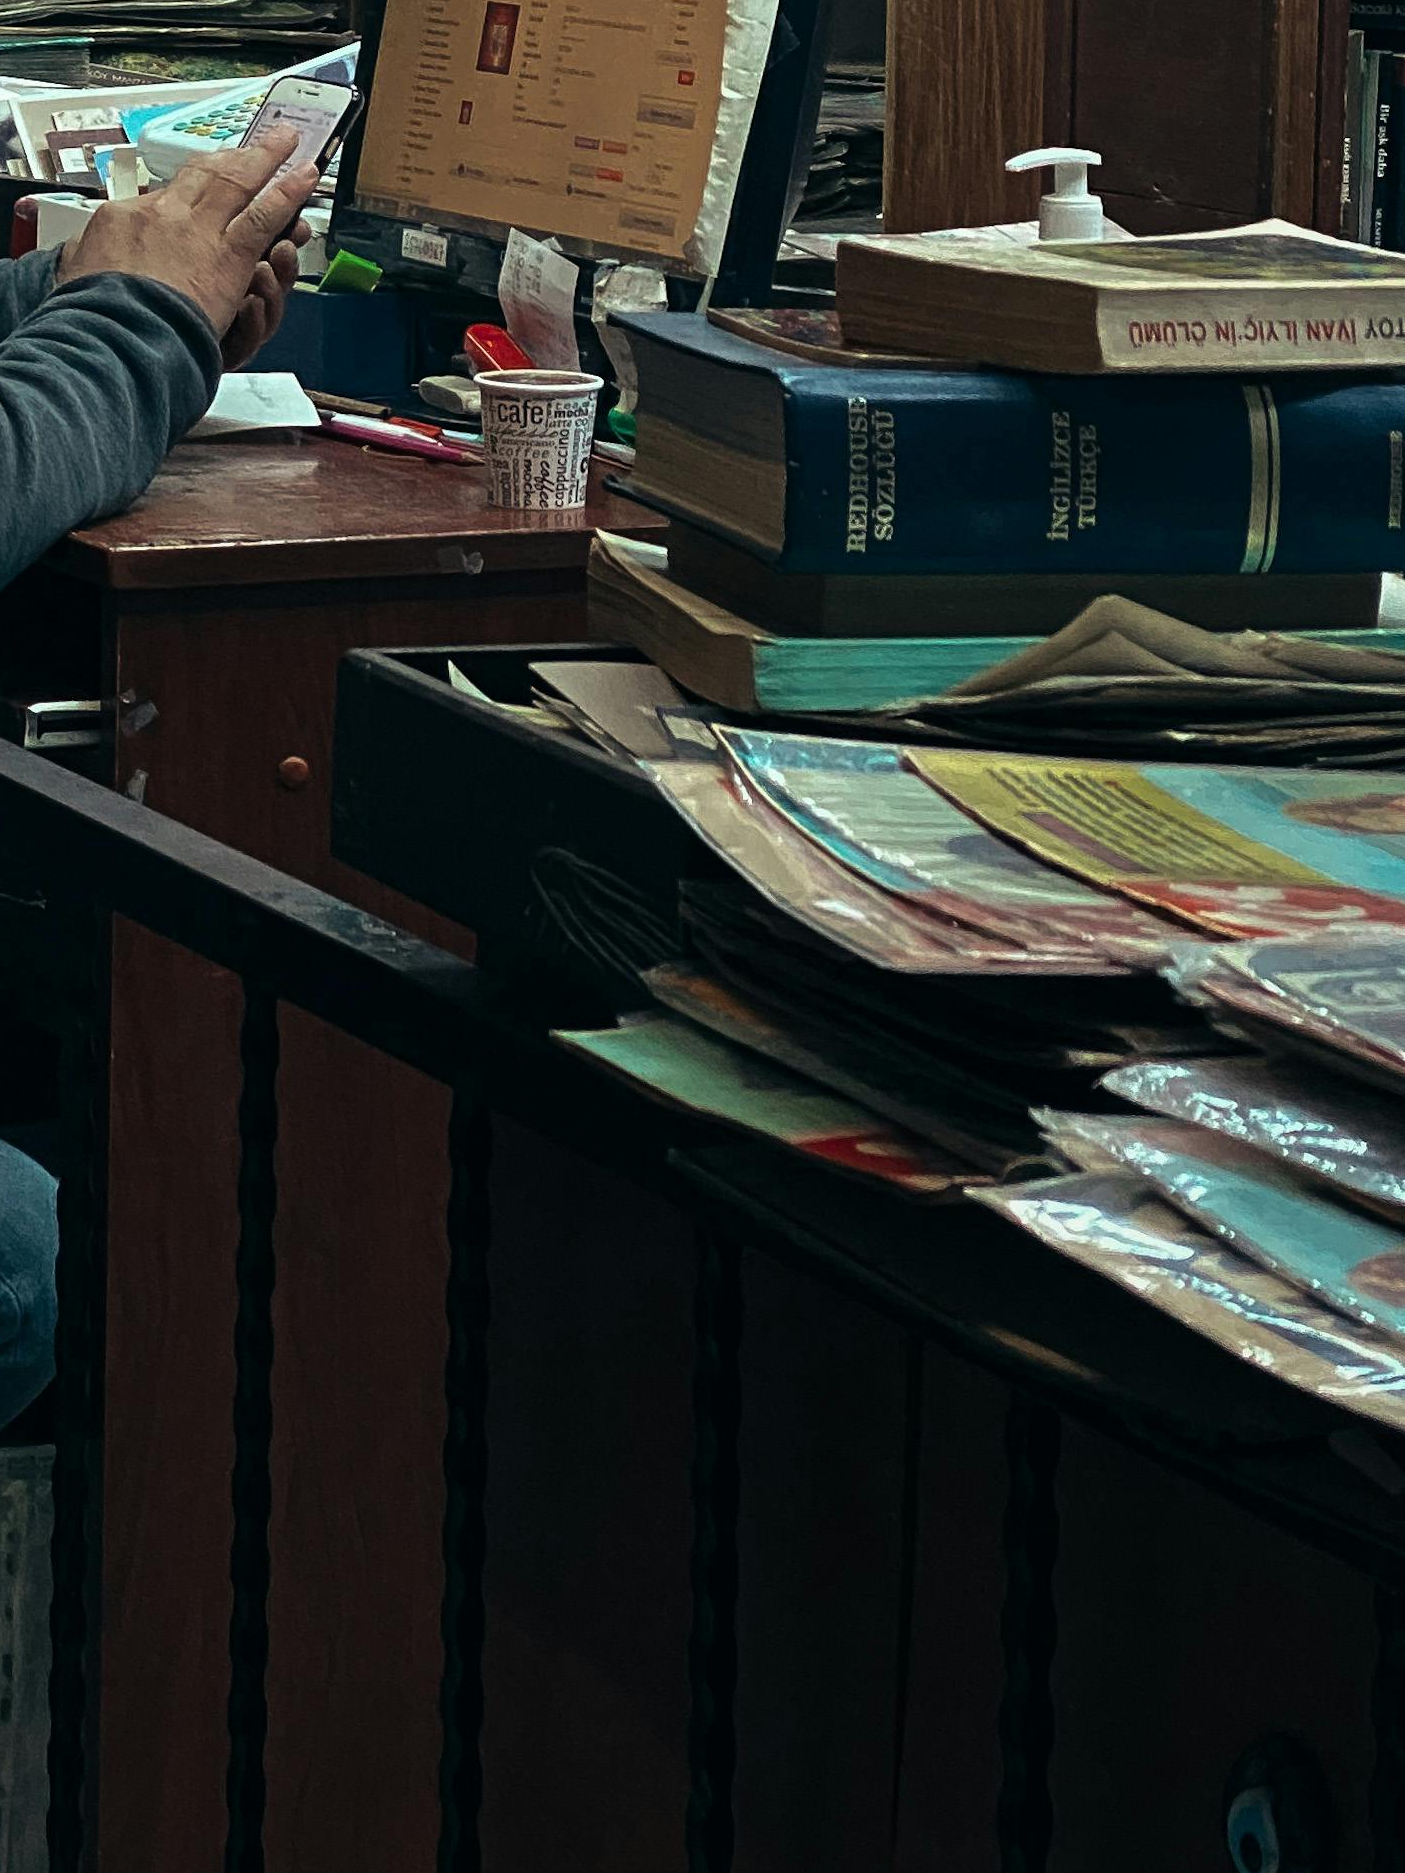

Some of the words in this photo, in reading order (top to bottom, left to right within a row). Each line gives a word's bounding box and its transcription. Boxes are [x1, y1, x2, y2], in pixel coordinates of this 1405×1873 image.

[1375, 148, 1388, 177] daha
[497, 399, 543, 428] cafe
[534, 460, 555, 509] coffee
[555, 429, 570, 508] cappuccino
[845, 397, 868, 553] REDHOUSE
[1076, 423, 1098, 529] TÜRKÇE
